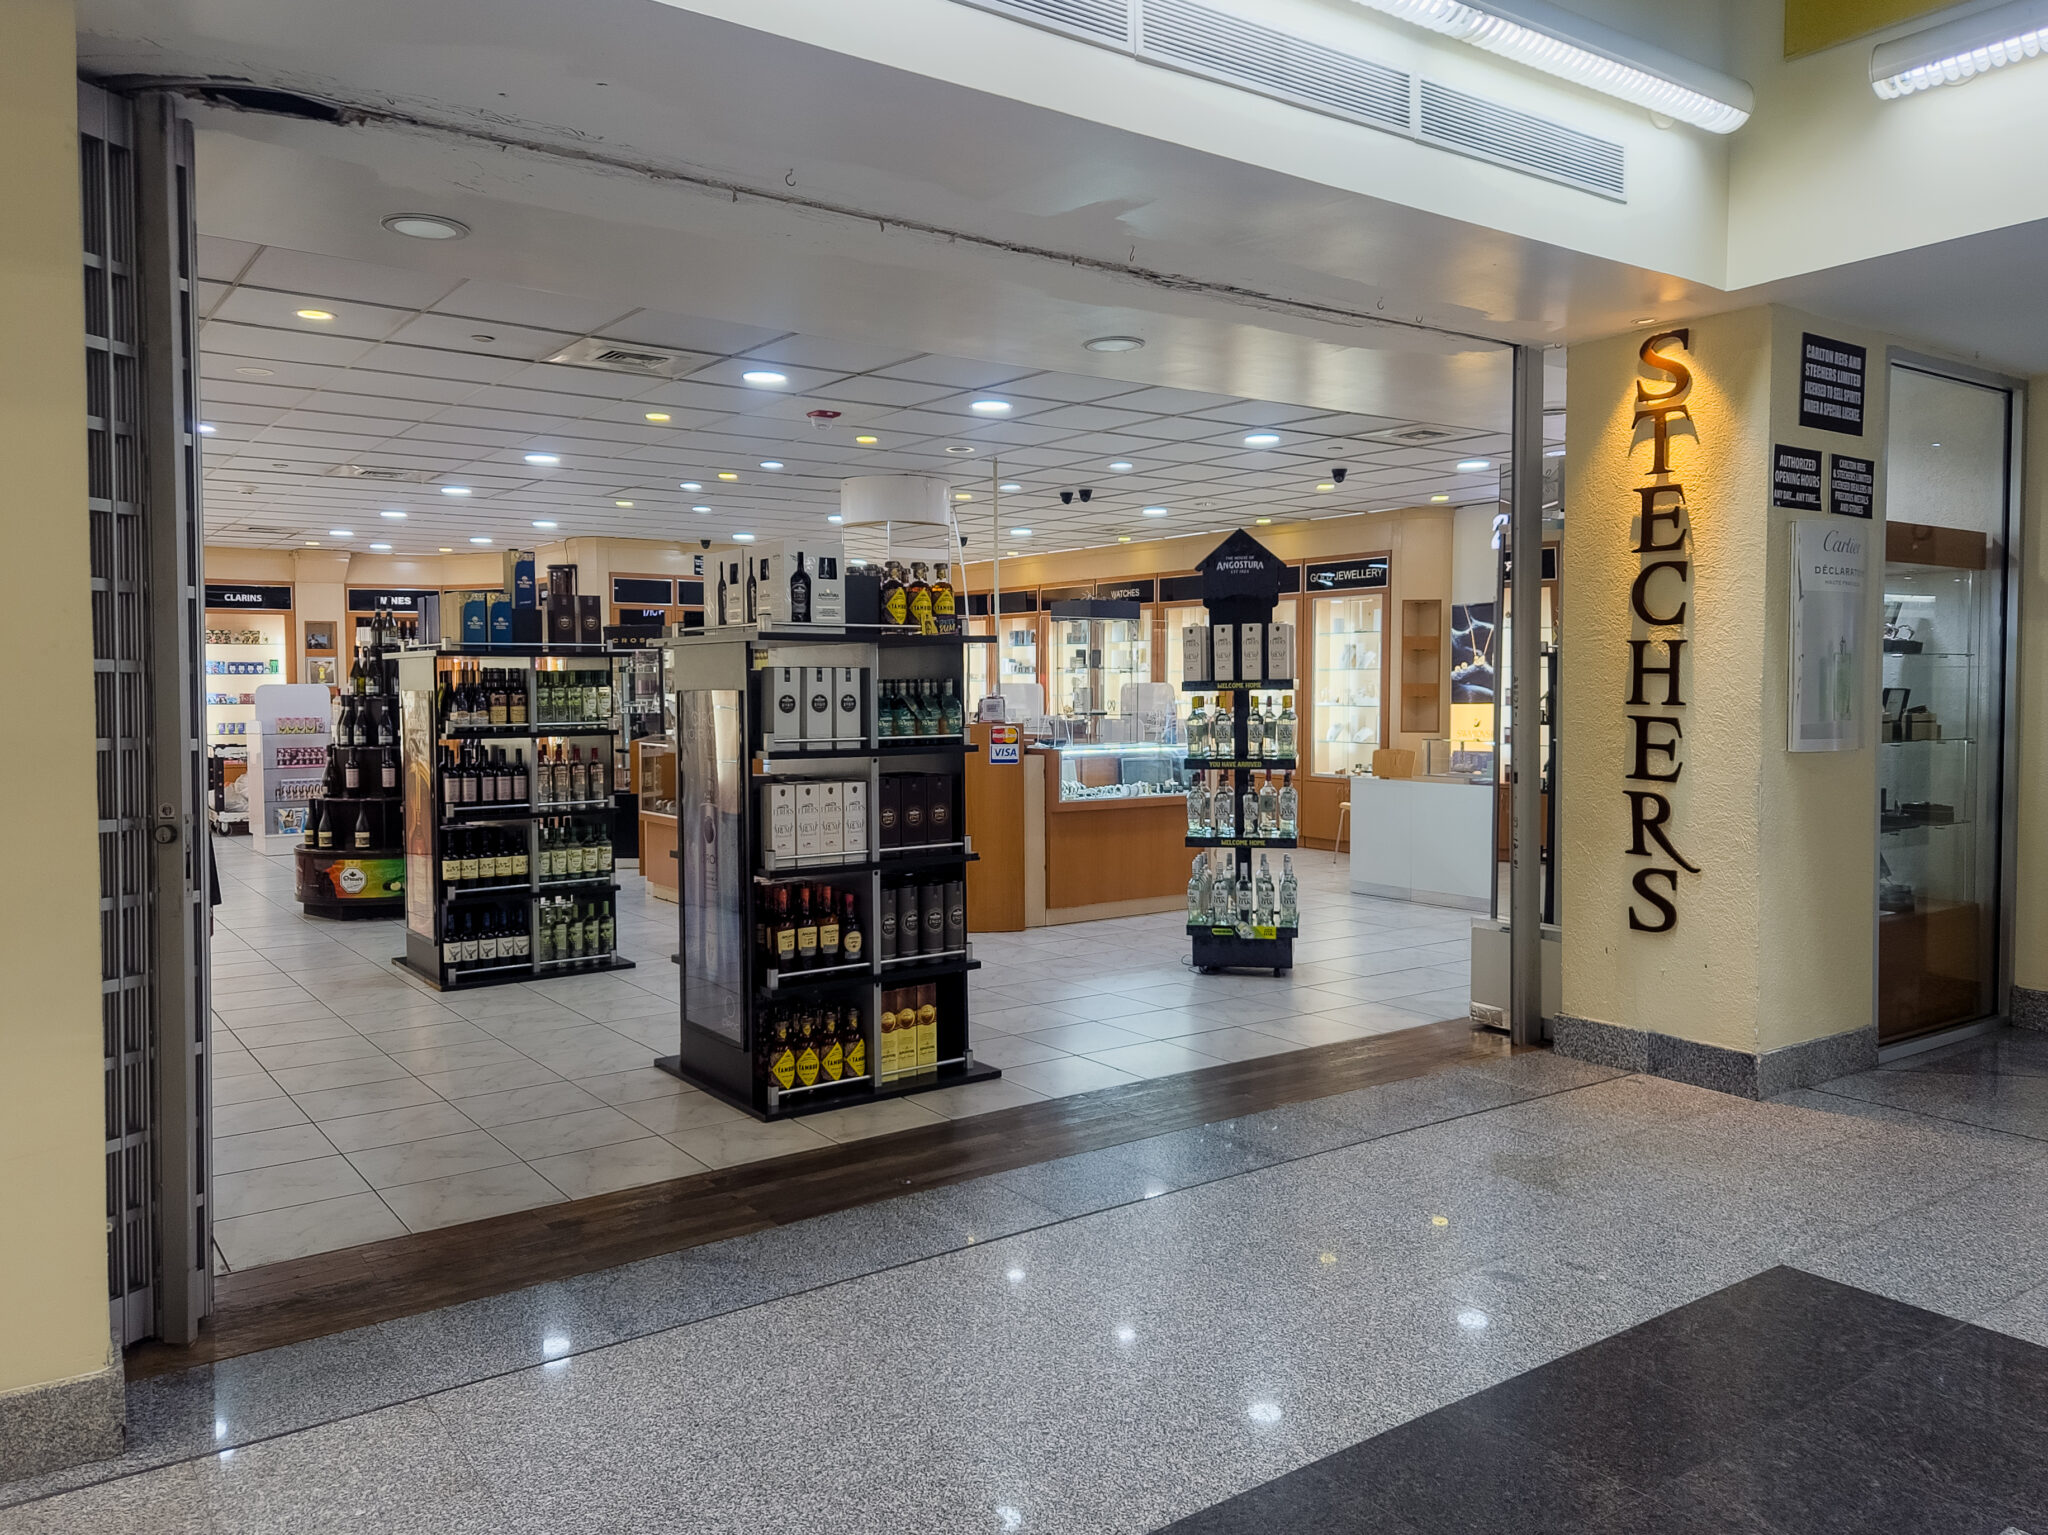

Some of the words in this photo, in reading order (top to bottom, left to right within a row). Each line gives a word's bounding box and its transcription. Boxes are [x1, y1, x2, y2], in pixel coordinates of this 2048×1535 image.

[1805, 363, 1836, 382] STECHERS
[1837, 370, 1861, 388] LIMITED
[1780, 454, 1817, 472] AUTHORIZED
[1775, 470, 1800, 485] OPENING
[1800, 474, 1820, 488] HOURS
[1837, 470, 1856, 481] STECHERS
[1823, 529, 1861, 554] Cartier
[1216, 560, 1264, 571] ANGOSTURA
[1334, 568, 1384, 581] JEWELLERY
[224, 593, 262, 602] CLARINS
[1110, 588, 1140, 598] WATCHES
[379, 596, 412, 606] WNES
[1624, 328, 1702, 933] STECHERS
[994, 748, 1017, 756] VISA
